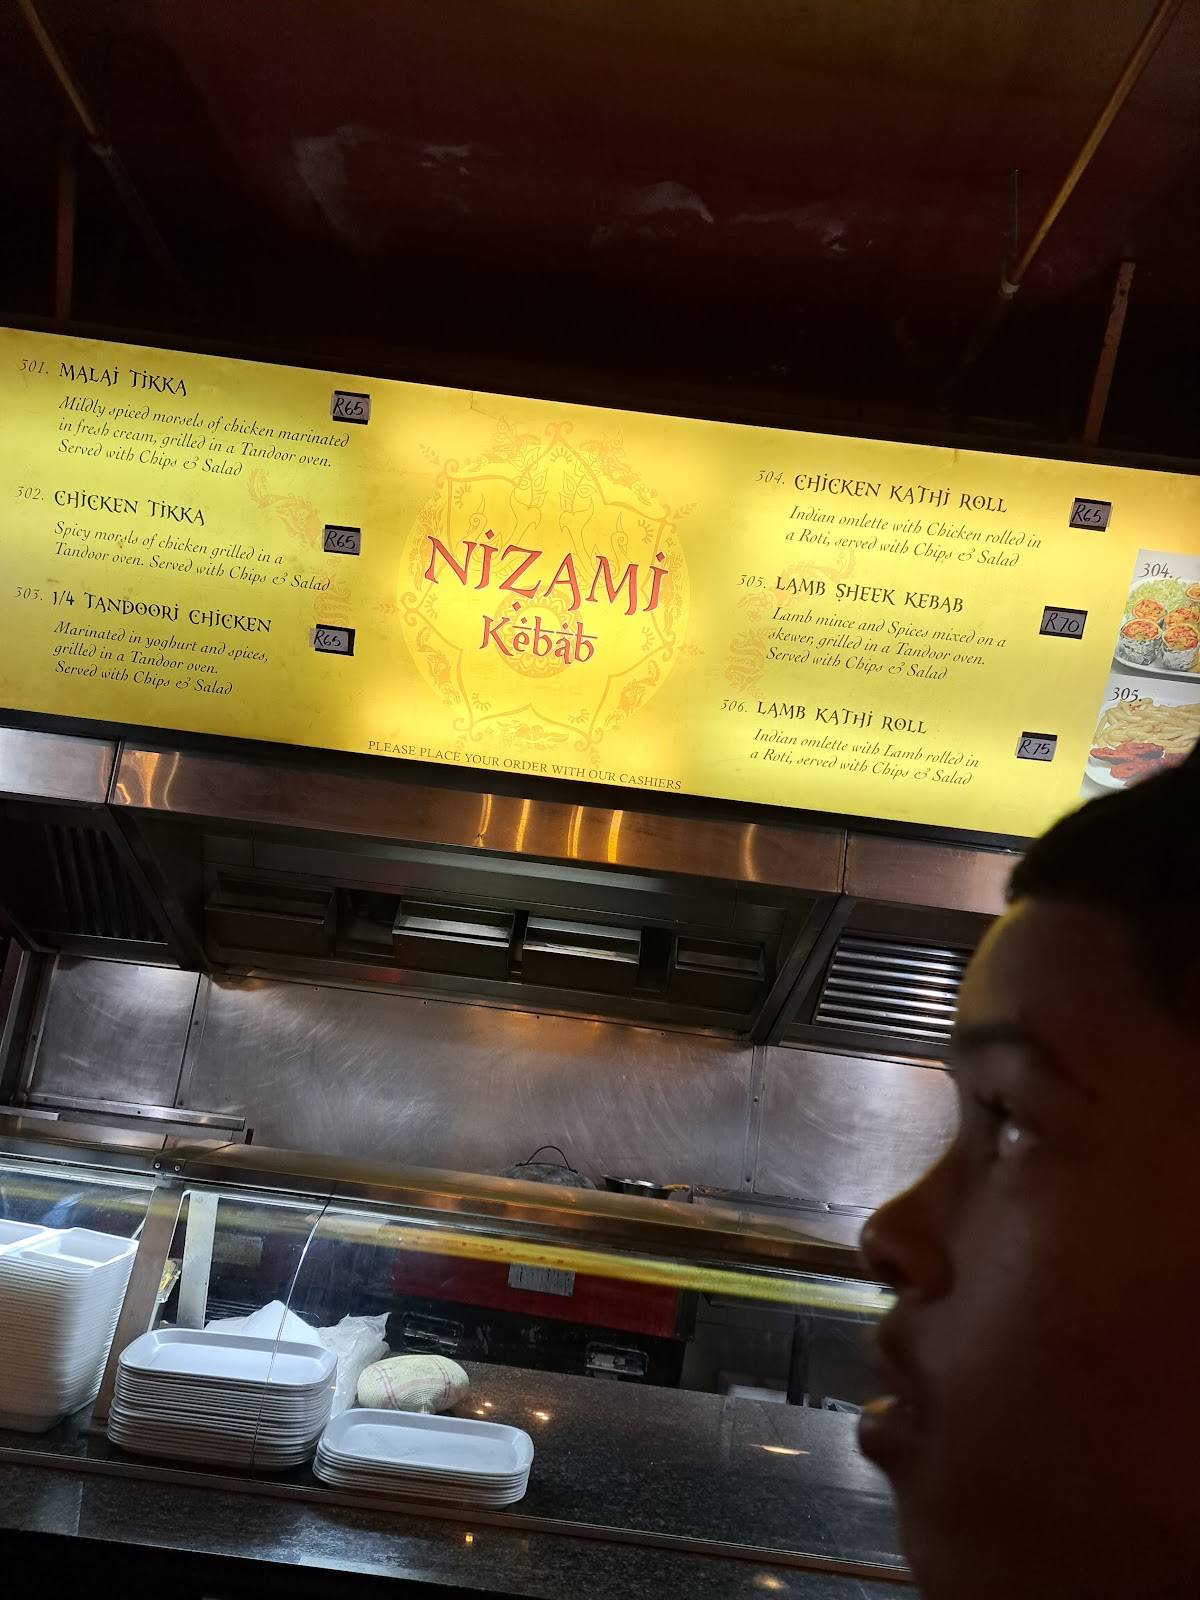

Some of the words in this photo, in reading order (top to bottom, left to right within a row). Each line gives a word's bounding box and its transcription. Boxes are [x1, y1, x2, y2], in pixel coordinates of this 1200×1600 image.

[19, 359, 49, 374] 301.
[59, 362, 119, 387] MALAI
[129, 370, 187, 397] TIKKA
[59, 396, 105, 417] Mildly
[109, 404, 150, 419] spiced
[153, 413, 204, 428] morsels
[208, 416, 223, 433] of
[224, 418, 274, 437] chicken
[278, 429, 350, 447] marinated
[333, 398, 364, 416] R65
[58, 439, 102, 457] Served
[106, 447, 134, 461] with
[139, 450, 177, 470] Chips
[183, 457, 199, 469] &
[202, 459, 242, 477] Salad
[59, 417, 72, 431] in
[74, 419, 109, 436] fresh
[113, 429, 157, 445] cream,
[162, 432, 206, 449] grilled
[209, 438, 221, 452] in
[226, 446, 234, 454] a
[241, 441, 297, 462] Tandoor
[299, 455, 331, 467] oven.
[15, 485, 44, 501] 302.
[54, 490, 138, 514] CHICKEN
[148, 500, 205, 526] TIKKA
[755, 469, 785, 485] 304.
[794, 474, 881, 497] CHICKEN
[889, 484, 951, 507] KATHI
[959, 493, 1008, 513] ROLL
[788, 505, 836, 524] Indian
[839, 513, 889, 531] omlette
[892, 519, 922, 535] with
[926, 521, 982, 542] Chicken
[985, 530, 1026, 546] rolled
[1027, 534, 1042, 549] in
[1071, 504, 1102, 523] R65
[54, 521, 90, 541] Spicy
[143, 534, 157, 550] of
[158, 536, 207, 554] chicken
[211, 544, 255, 561] grilled
[258, 549, 270, 562] in
[275, 555, 283, 565] a
[324, 530, 356, 549] R65
[785, 531, 794, 541] a
[798, 528, 830, 546] Roti,
[835, 536, 878, 550] served
[880, 539, 909, 554] with
[913, 542, 952, 562] Chips
[957, 548, 975, 562] &
[977, 549, 1020, 568] Salad
[55, 541, 109, 561] Tandoor
[112, 554, 144, 566] oven.
[149, 555, 192, 573] Served
[196, 563, 225, 577] with
[229, 566, 266, 585] Chips
[272, 573, 288, 585] &
[290, 574, 331, 592] Salad
[424, 529, 668, 616] NIZAMI
[1137, 562, 1173, 579] 304.
[15, 586, 43, 601] 303.
[52, 590, 75, 606] 1/4
[84, 591, 179, 622] TANDOORI
[189, 608, 272, 633] CHICKEN
[737, 574, 766, 589] 305.
[776, 576, 826, 596] LAMB
[836, 583, 896, 606] SHEEK
[904, 591, 964, 613] KEBAB
[54, 621, 126, 642] Marinated
[129, 630, 142, 644] in
[145, 635, 197, 652] yoghurt
[201, 642, 226, 655] and
[228, 646, 268, 663] spices,
[479, 614, 598, 665] Kebab
[771, 606, 813, 624] Lamb
[816, 614, 854, 629] mince
[858, 619, 886, 633] and
[887, 621, 929, 639] Spices
[932, 627, 976, 644] mixed
[977, 636, 993, 646] on
[997, 639, 1007, 647] a
[1044, 613, 1080, 633] R70
[53, 642, 96, 657] grilled
[100, 647, 113, 660] in
[117, 653, 124, 661] a
[131, 650, 184, 669] Tandoor
[187, 661, 218, 674] oven.
[766, 646, 810, 663] Served
[812, 653, 841, 667] with
[845, 656, 883, 676] Chips
[888, 662, 905, 675] &
[906, 664, 948, 680] Salad
[768, 627, 815, 646] skewer,
[818, 634, 862, 649] grilled
[864, 638, 878, 652] in
[881, 645, 890, 654] a
[895, 642, 951, 661] Tandoor
[953, 653, 985, 665] oven.
[55, 660, 98, 677] Served
[101, 667, 129, 681] with
[133, 671, 171, 690] Chips
[176, 677, 191, 689] &
[194, 678, 233, 695] Salad
[1107, 687, 1142, 703] 305.
[720, 699, 748, 713] 306.
[756, 701, 806, 720] LAMB
[816, 707, 873, 728] KATHI
[881, 715, 927, 734] ROLL
[368, 741, 416, 756] PLEASE
[420, 747, 461, 761] PLACE
[465, 753, 500, 767] YOUR
[503, 758, 547, 772] ORDER
[552, 764, 585, 777] WITH
[588, 769, 616, 782] OUR
[619, 773, 681, 790] CASHIERS
[750, 750, 759, 759] a
[763, 748, 793, 765] Roti,
[797, 755, 838, 768] served
[840, 758, 868, 772] with
[872, 761, 909, 780] Chips
[914, 767, 932, 779] &
[932, 769, 973, 785] Salad
[753, 728, 798, 745] Indian
[800, 735, 849, 752] omlette
[852, 741, 880, 755] with
[883, 744, 923, 761] Lamb
[926, 752, 965, 767] rolled
[966, 754, 980, 768] in
[1017, 739, 1050, 755] R75
